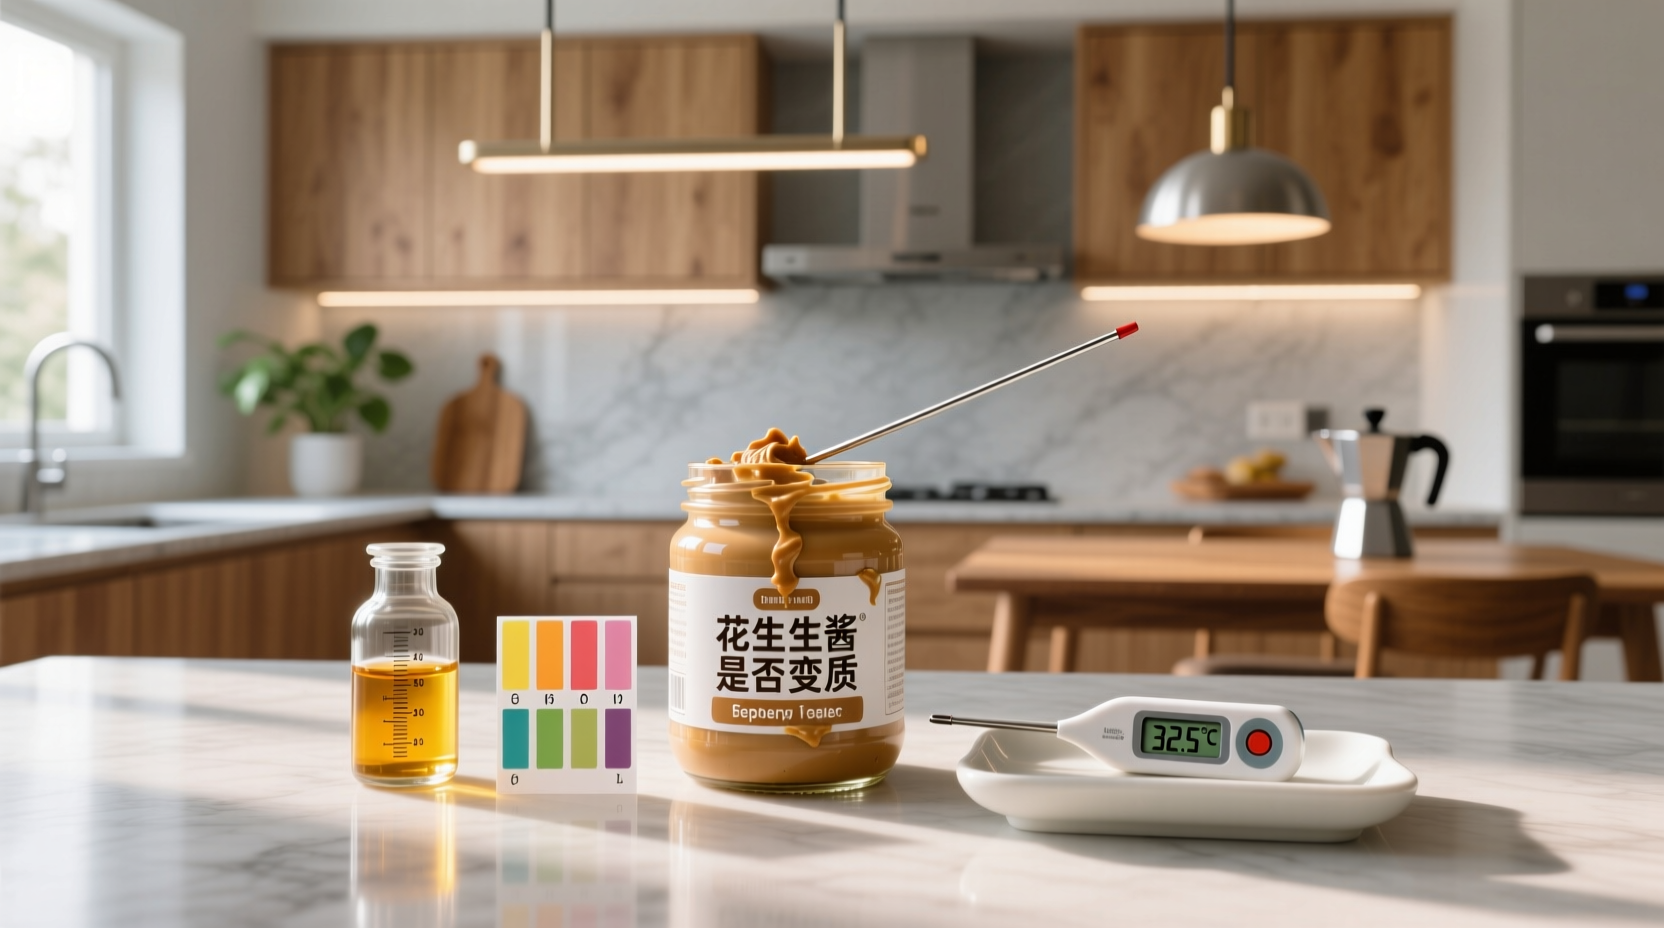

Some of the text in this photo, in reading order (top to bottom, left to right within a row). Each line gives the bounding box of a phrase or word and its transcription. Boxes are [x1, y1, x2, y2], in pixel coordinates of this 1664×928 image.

[716, 613, 858, 653] 花生生酱
[716, 654, 858, 694] 是否变质
